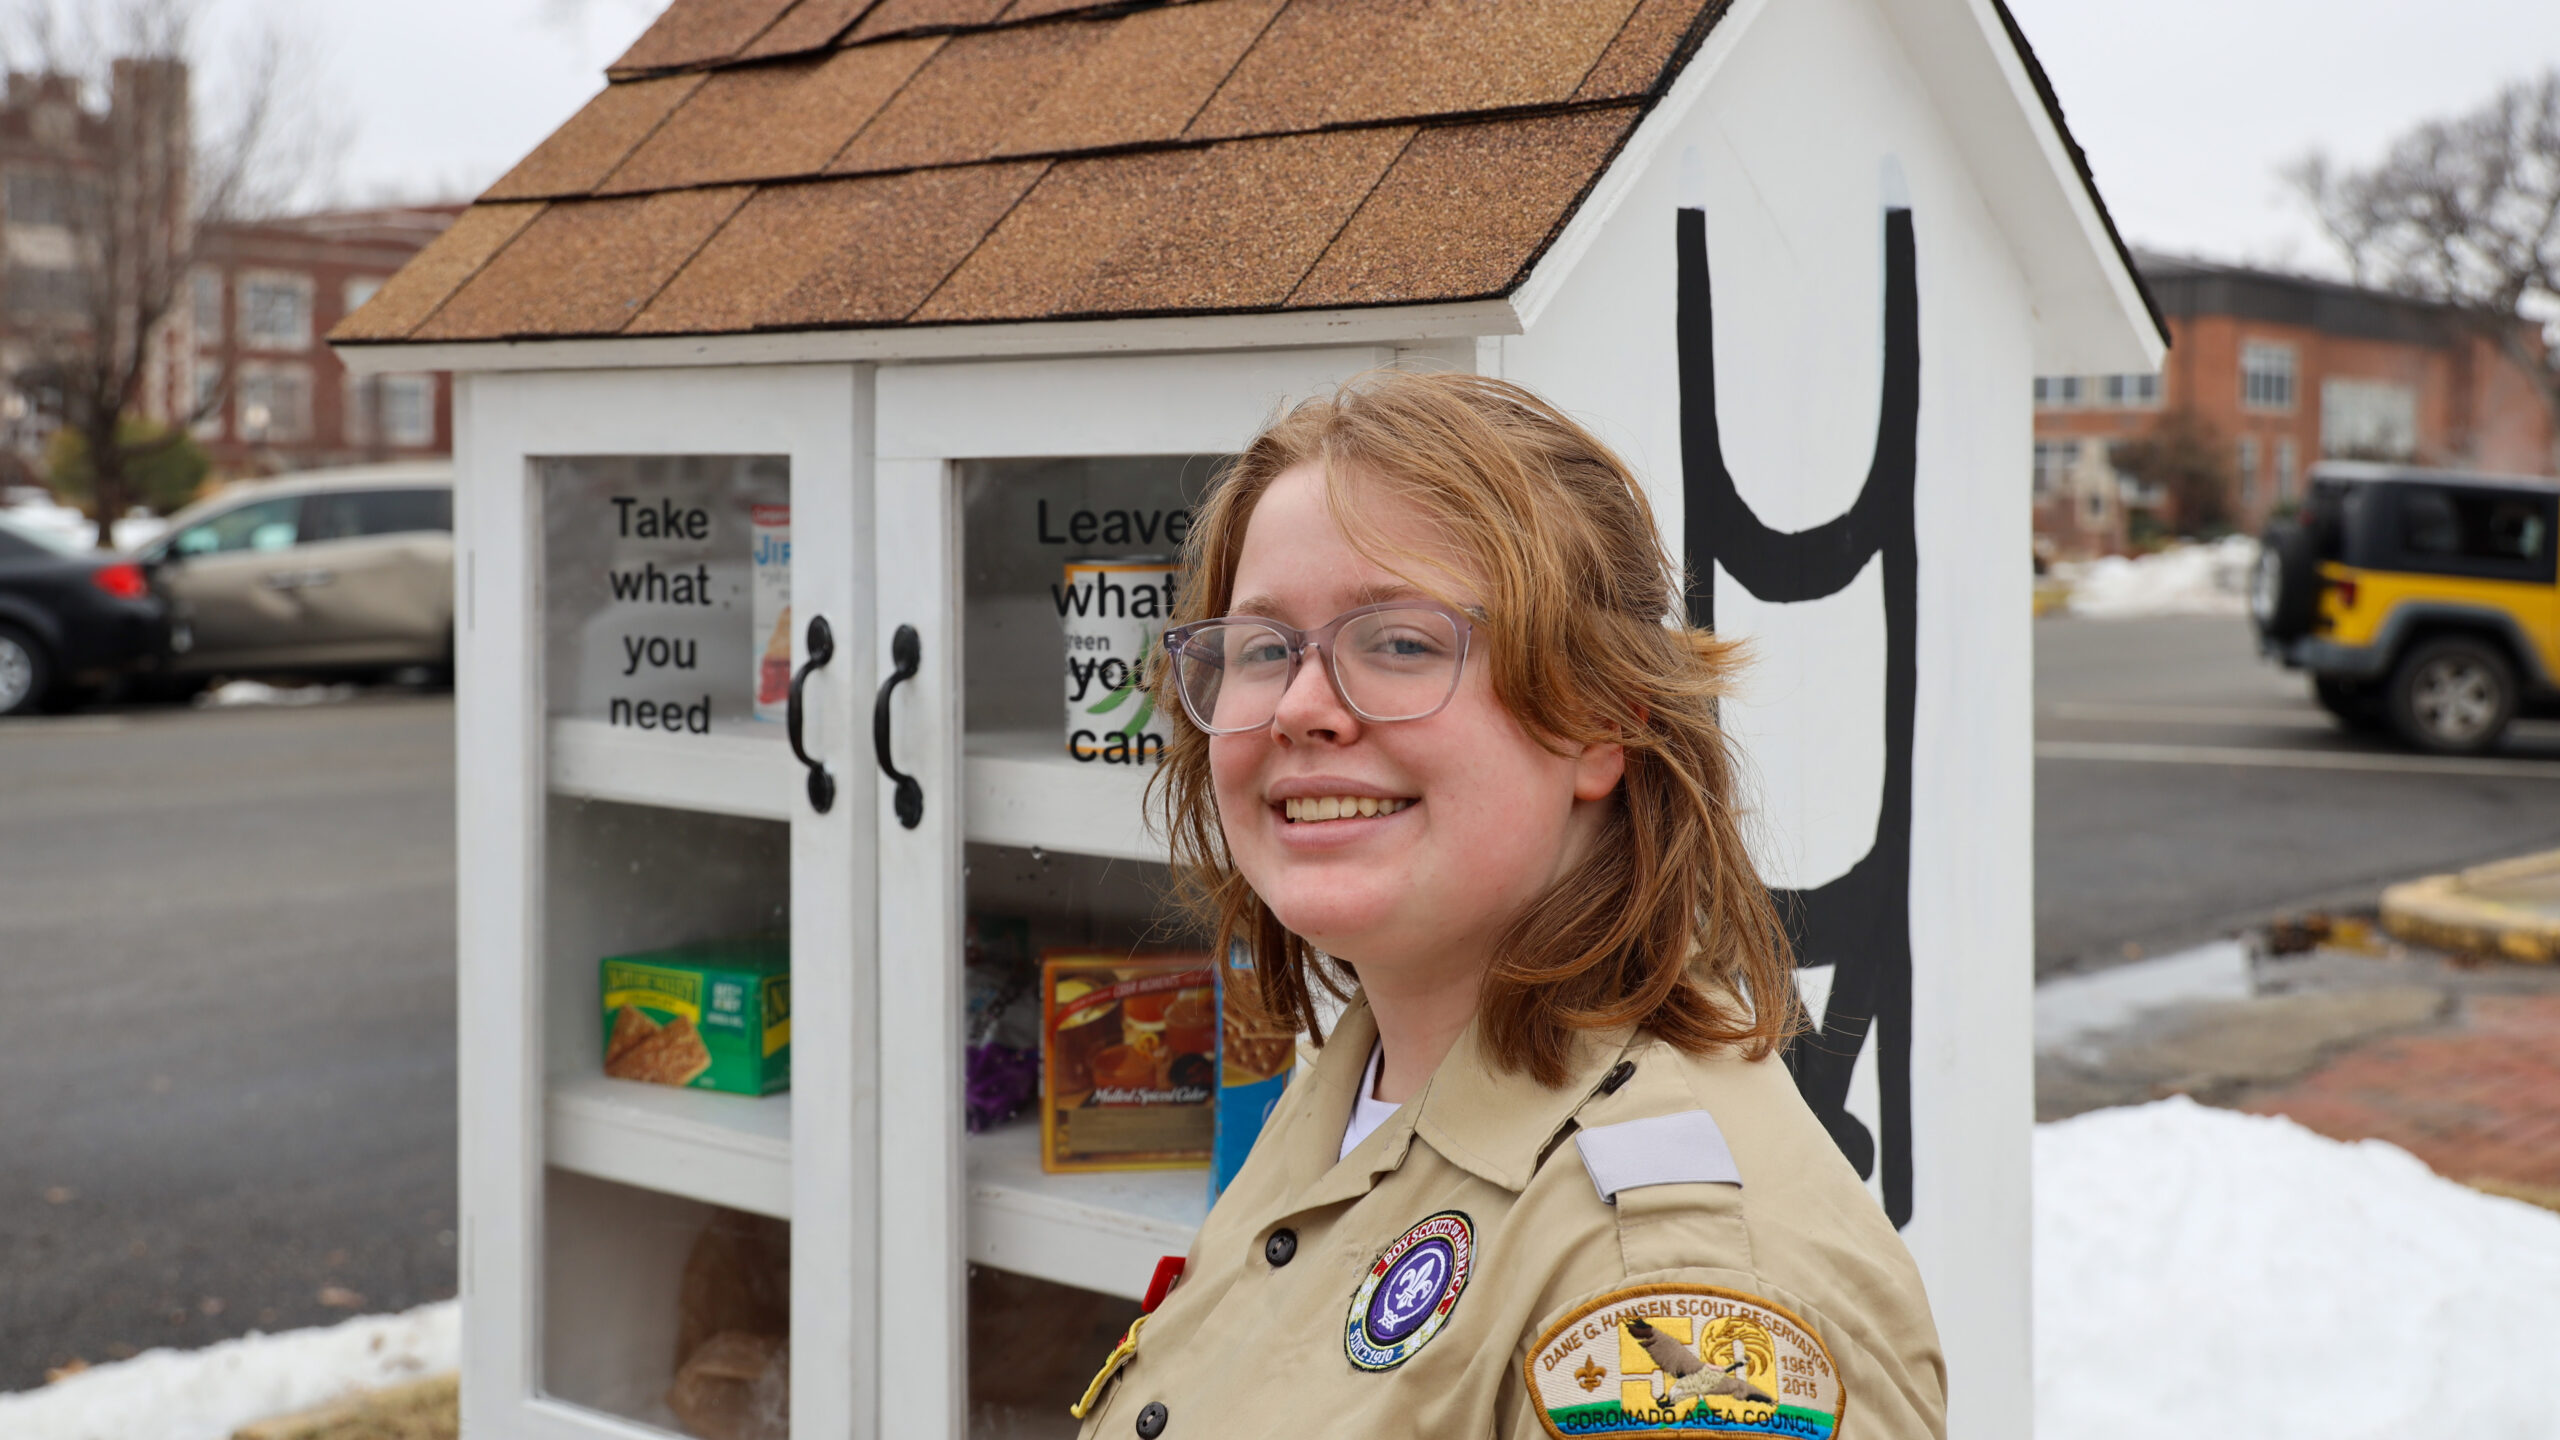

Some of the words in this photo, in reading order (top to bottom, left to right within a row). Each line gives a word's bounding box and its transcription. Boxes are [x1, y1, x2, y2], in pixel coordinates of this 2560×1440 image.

[610, 497, 708, 540] Take
[1037, 499, 1193, 546] Leave
[610, 563, 713, 606] what
[1051, 571, 1178, 620] what
[622, 634, 697, 676] you
[610, 694, 711, 735] need
[1069, 729, 1164, 766] can
[1383, 1234, 1411, 1266] BOY
[1411, 1219, 1456, 1243] SCOUTS
[1444, 1231, 1469, 1300] AMERICA
[1350, 1327, 1372, 1361] SINCE
[1365, 1348, 1395, 1364] 1910
[1543, 1329, 1584, 1372] DANE
[1583, 1322, 1601, 1340] G.
[1676, 1299, 1736, 1318] SCOUT
[1739, 1305, 1830, 1378] RESERVATION
[1780, 1355, 1816, 1377] 1965
[1782, 1377, 1818, 1400] 2015
[1566, 1408, 1676, 1430] CORONADO
[1682, 1408, 1738, 1426] AREA
[1742, 1409, 1819, 1435] COUNCIL
